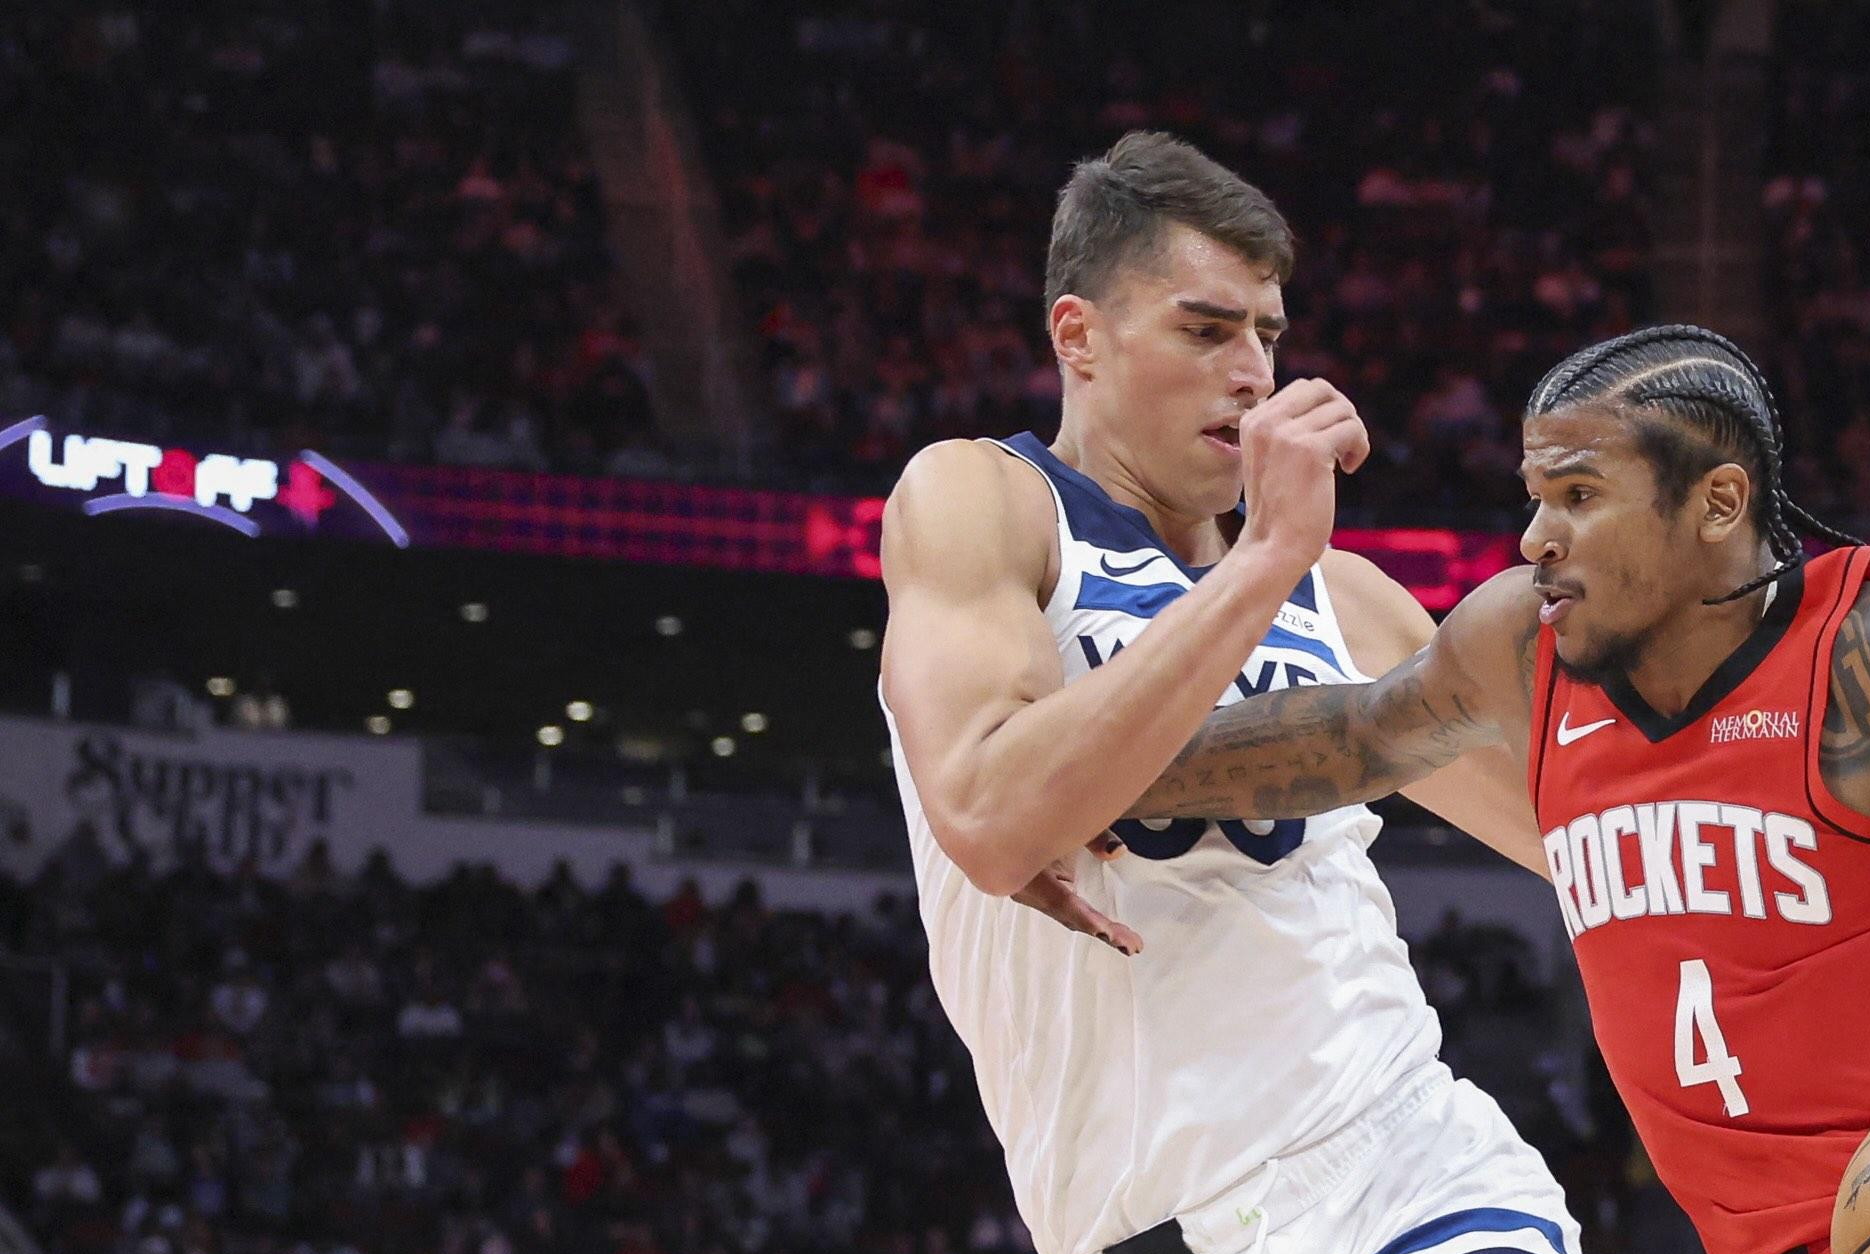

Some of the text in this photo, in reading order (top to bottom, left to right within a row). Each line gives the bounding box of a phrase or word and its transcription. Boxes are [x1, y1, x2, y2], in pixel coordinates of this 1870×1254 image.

[1711, 724, 1799, 743] HERMANN
[1712, 709, 1799, 731] MEMORIAL
[1543, 800, 1832, 943] ROCKETS
[1674, 958, 1749, 1118] 4
